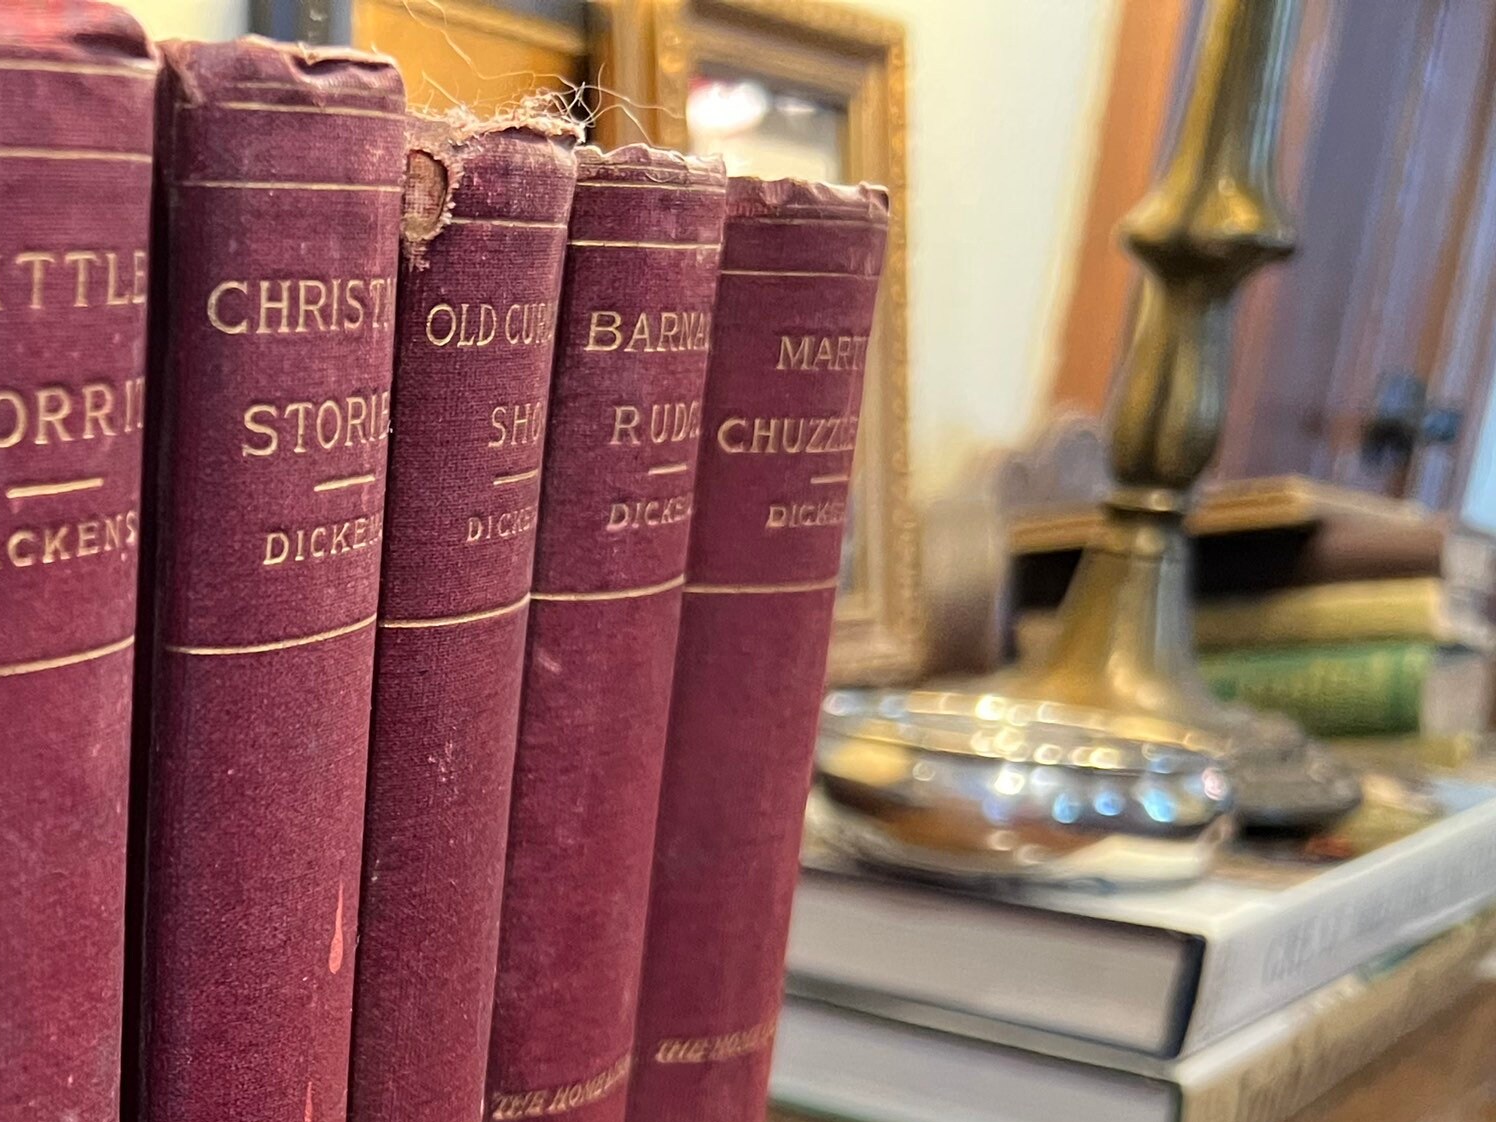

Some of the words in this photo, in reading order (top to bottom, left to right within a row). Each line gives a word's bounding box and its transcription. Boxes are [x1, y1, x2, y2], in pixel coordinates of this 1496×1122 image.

[425, 302, 498, 347] OLD
[584, 310, 711, 352] BARNA
[465, 503, 537, 544] DICKE
